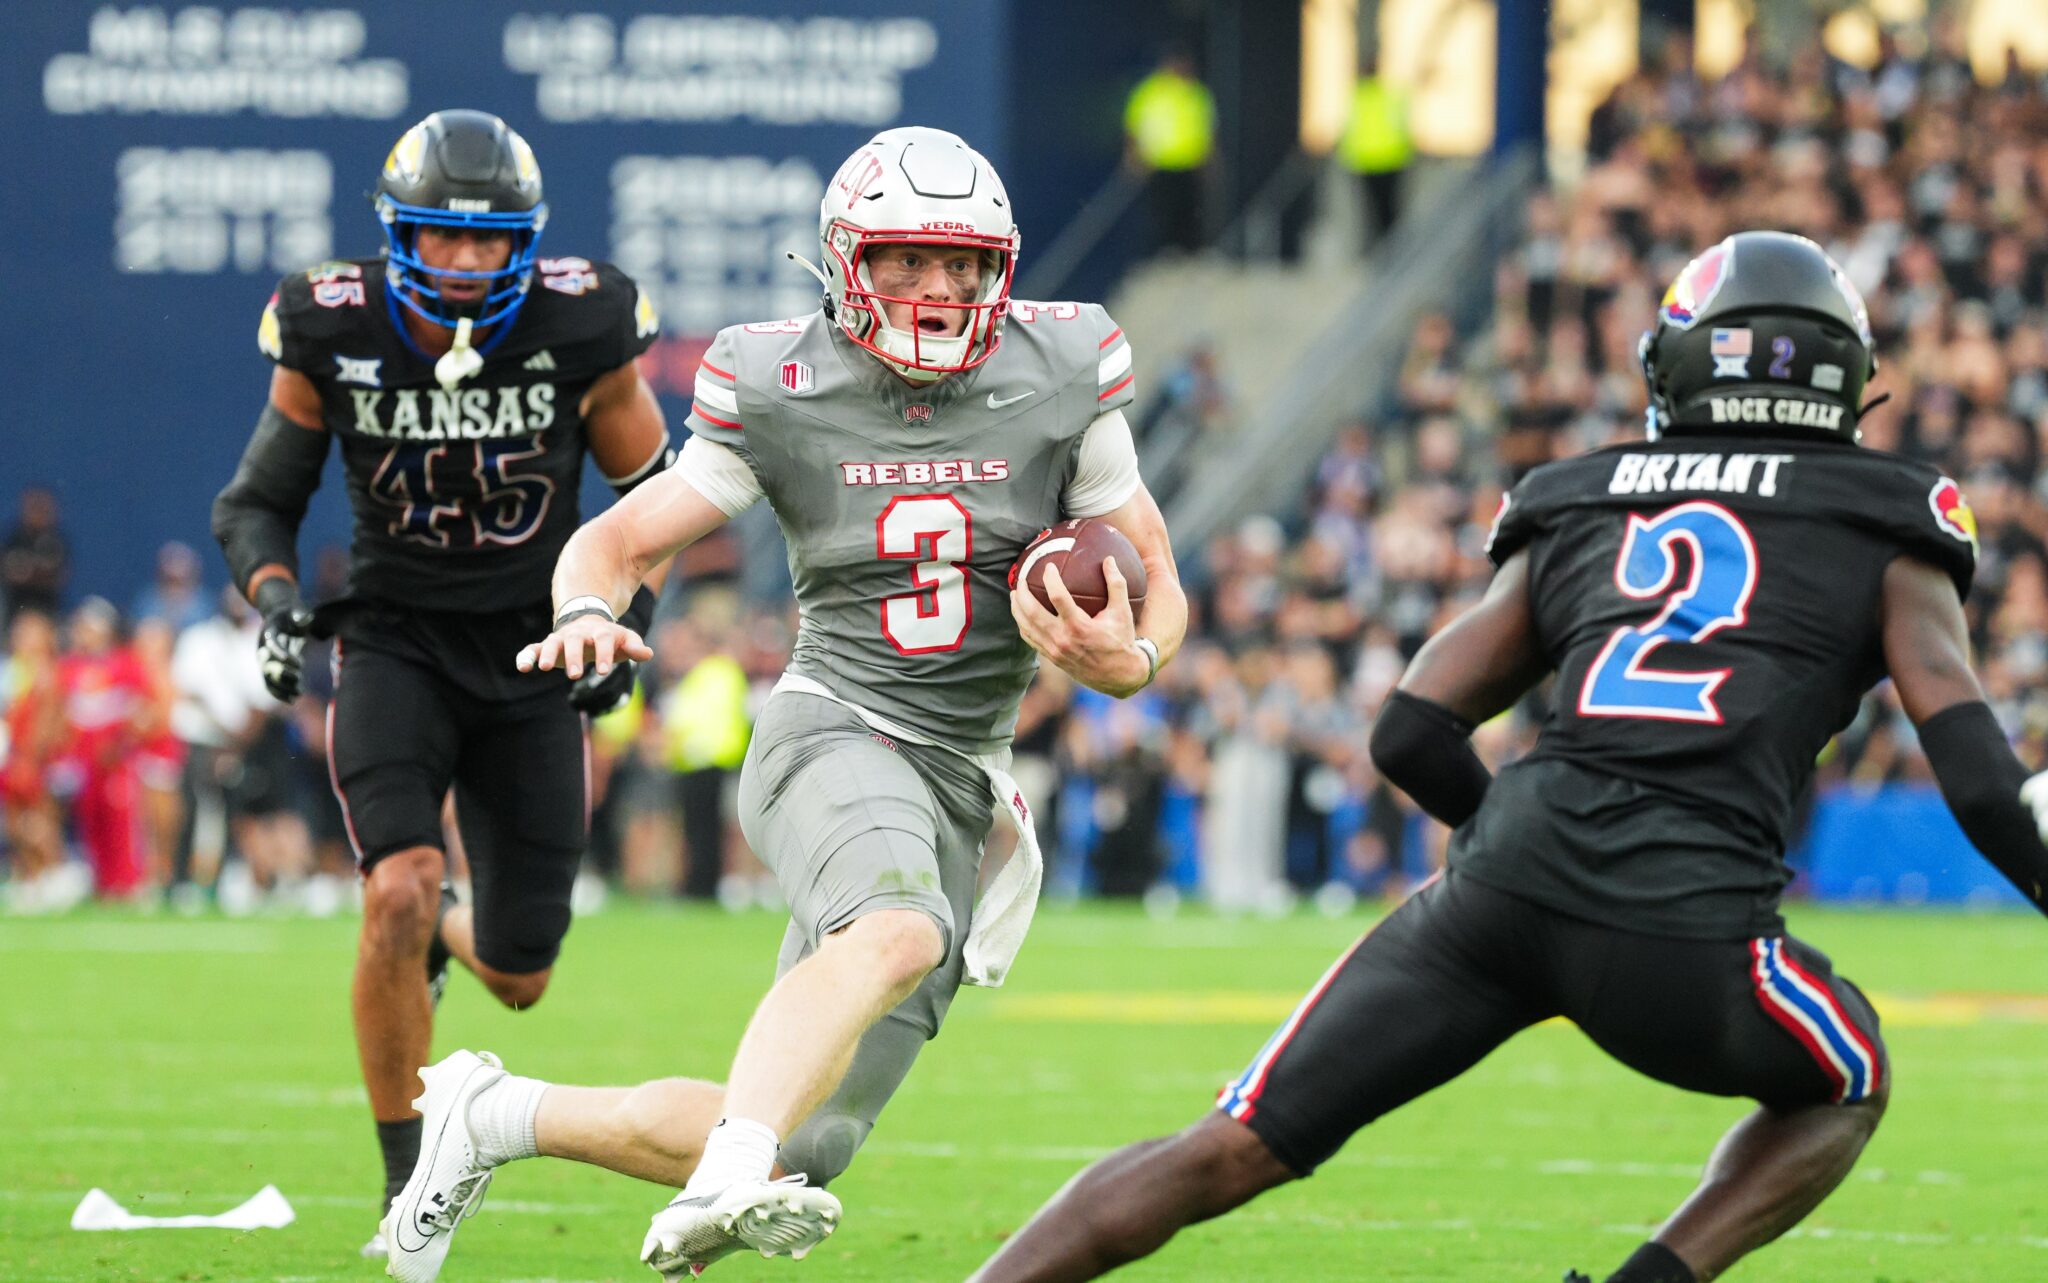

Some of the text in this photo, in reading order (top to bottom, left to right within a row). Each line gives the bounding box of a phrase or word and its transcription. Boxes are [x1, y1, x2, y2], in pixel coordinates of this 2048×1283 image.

[920, 221, 975, 233] VEGAS
[1768, 336, 1796, 379] 2
[349, 382, 556, 440] KANSAS
[904, 404, 931, 423] UNLV
[1711, 397, 1845, 430] ROCK CHALK
[369, 432, 556, 549] 45
[841, 459, 1009, 486] REBELS
[1609, 452, 1795, 497] BRYANT
[876, 493, 972, 656] 3
[1579, 500, 1760, 724] 2
